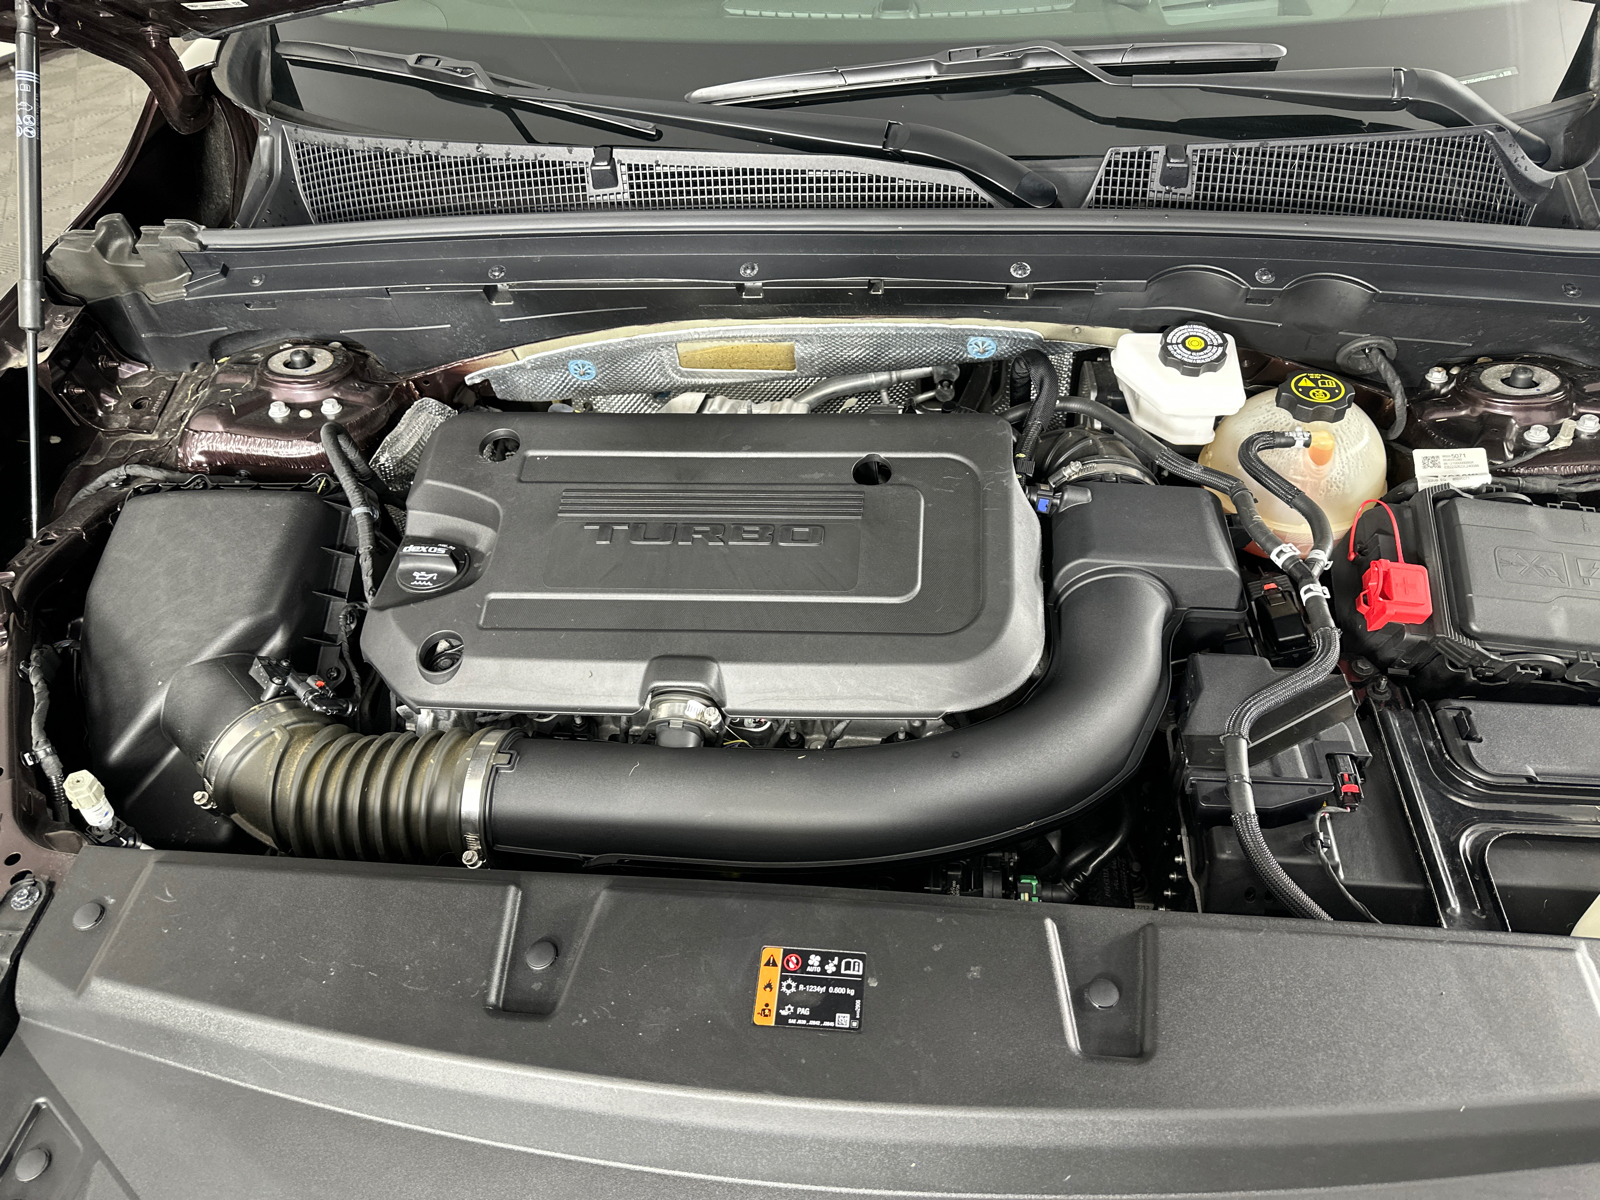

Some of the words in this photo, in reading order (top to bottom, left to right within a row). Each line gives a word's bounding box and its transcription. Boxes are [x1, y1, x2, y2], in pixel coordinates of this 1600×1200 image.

[584, 522, 825, 547] TURBO
[402, 544, 448, 554] dexos
[798, 984, 827, 994] R-1234yf
[828, 986, 846, 994] 0.600
[846, 987, 855, 996] kg
[796, 1007, 810, 1015] PAG
